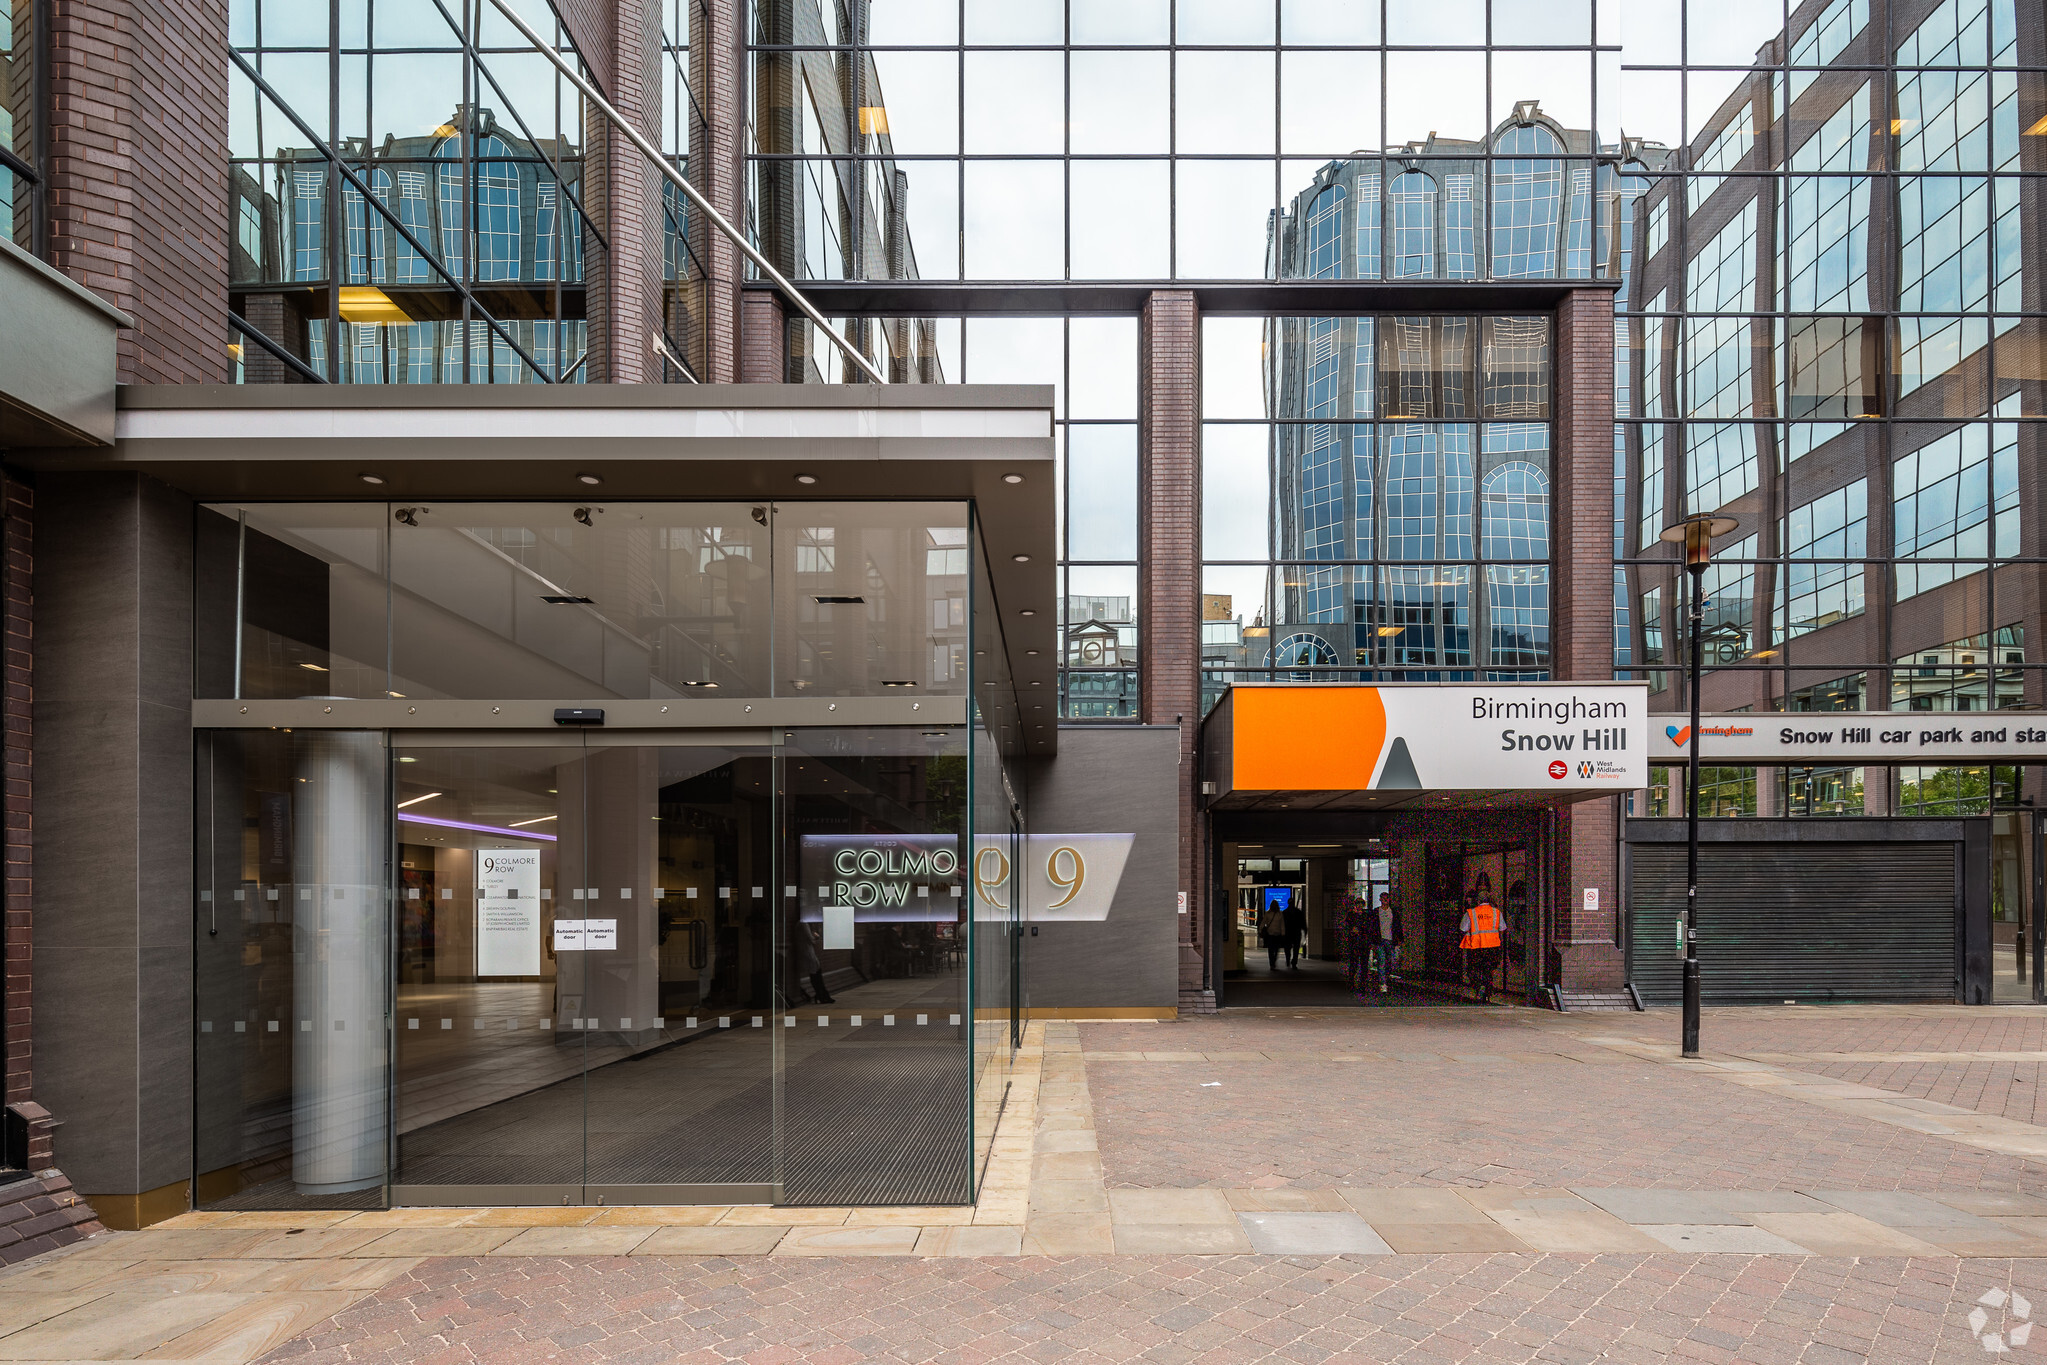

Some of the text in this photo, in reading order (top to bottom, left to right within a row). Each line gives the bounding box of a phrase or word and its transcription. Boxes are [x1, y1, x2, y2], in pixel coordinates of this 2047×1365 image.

[1472, 696, 1627, 724] Birmingham
[1501, 727, 1627, 751] Snow Hill
[1699, 725, 1753, 737] irmingham
[1780, 727, 2047, 746] Snow Hill car park and sta
[484, 857, 494, 873] 9
[1047, 847, 1086, 908] 9
[835, 882, 909, 906] ROW
